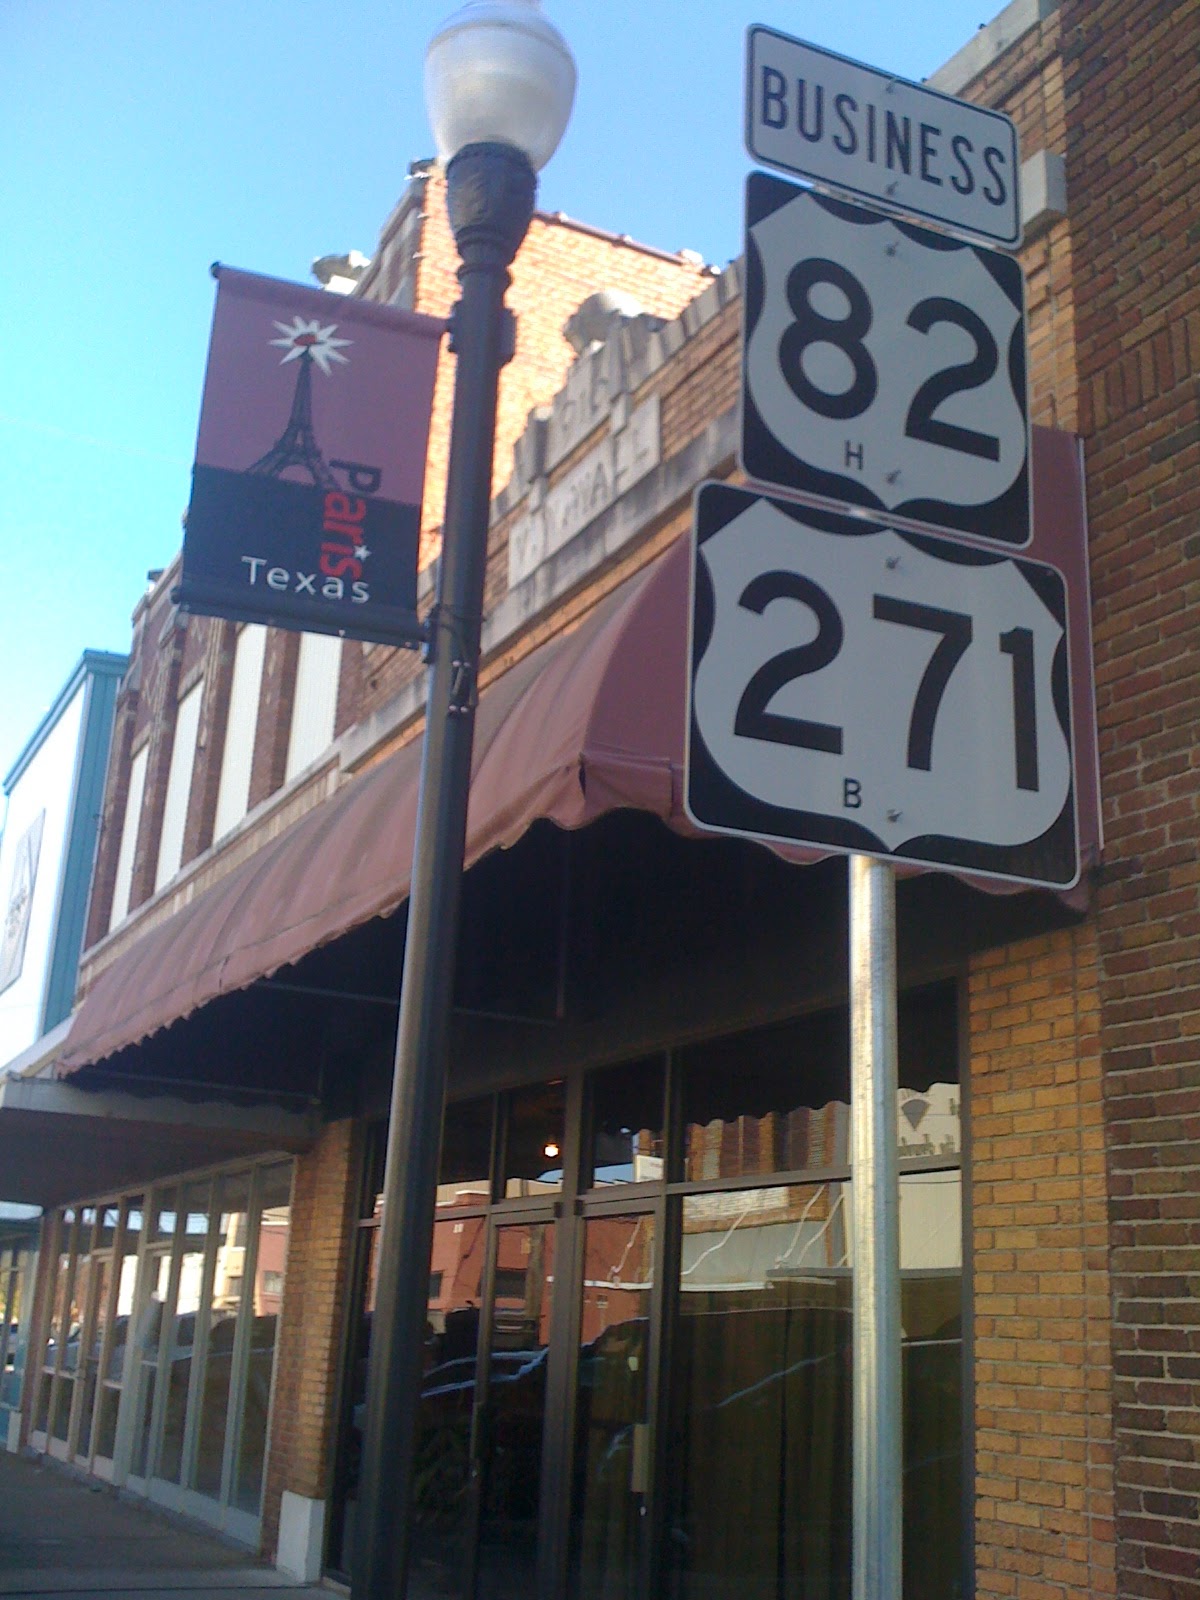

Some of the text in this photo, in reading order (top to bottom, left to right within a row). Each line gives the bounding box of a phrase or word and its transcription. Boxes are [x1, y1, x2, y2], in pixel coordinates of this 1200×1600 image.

[761, 65, 1007, 206] BUSINESS
[777, 256, 1000, 463] 82
[844, 440, 864, 470] H
[241, 555, 370, 605] Texas
[319, 458, 382, 580] Paris
[734, 569, 1040, 793] 271
[842, 777, 862, 808] B
